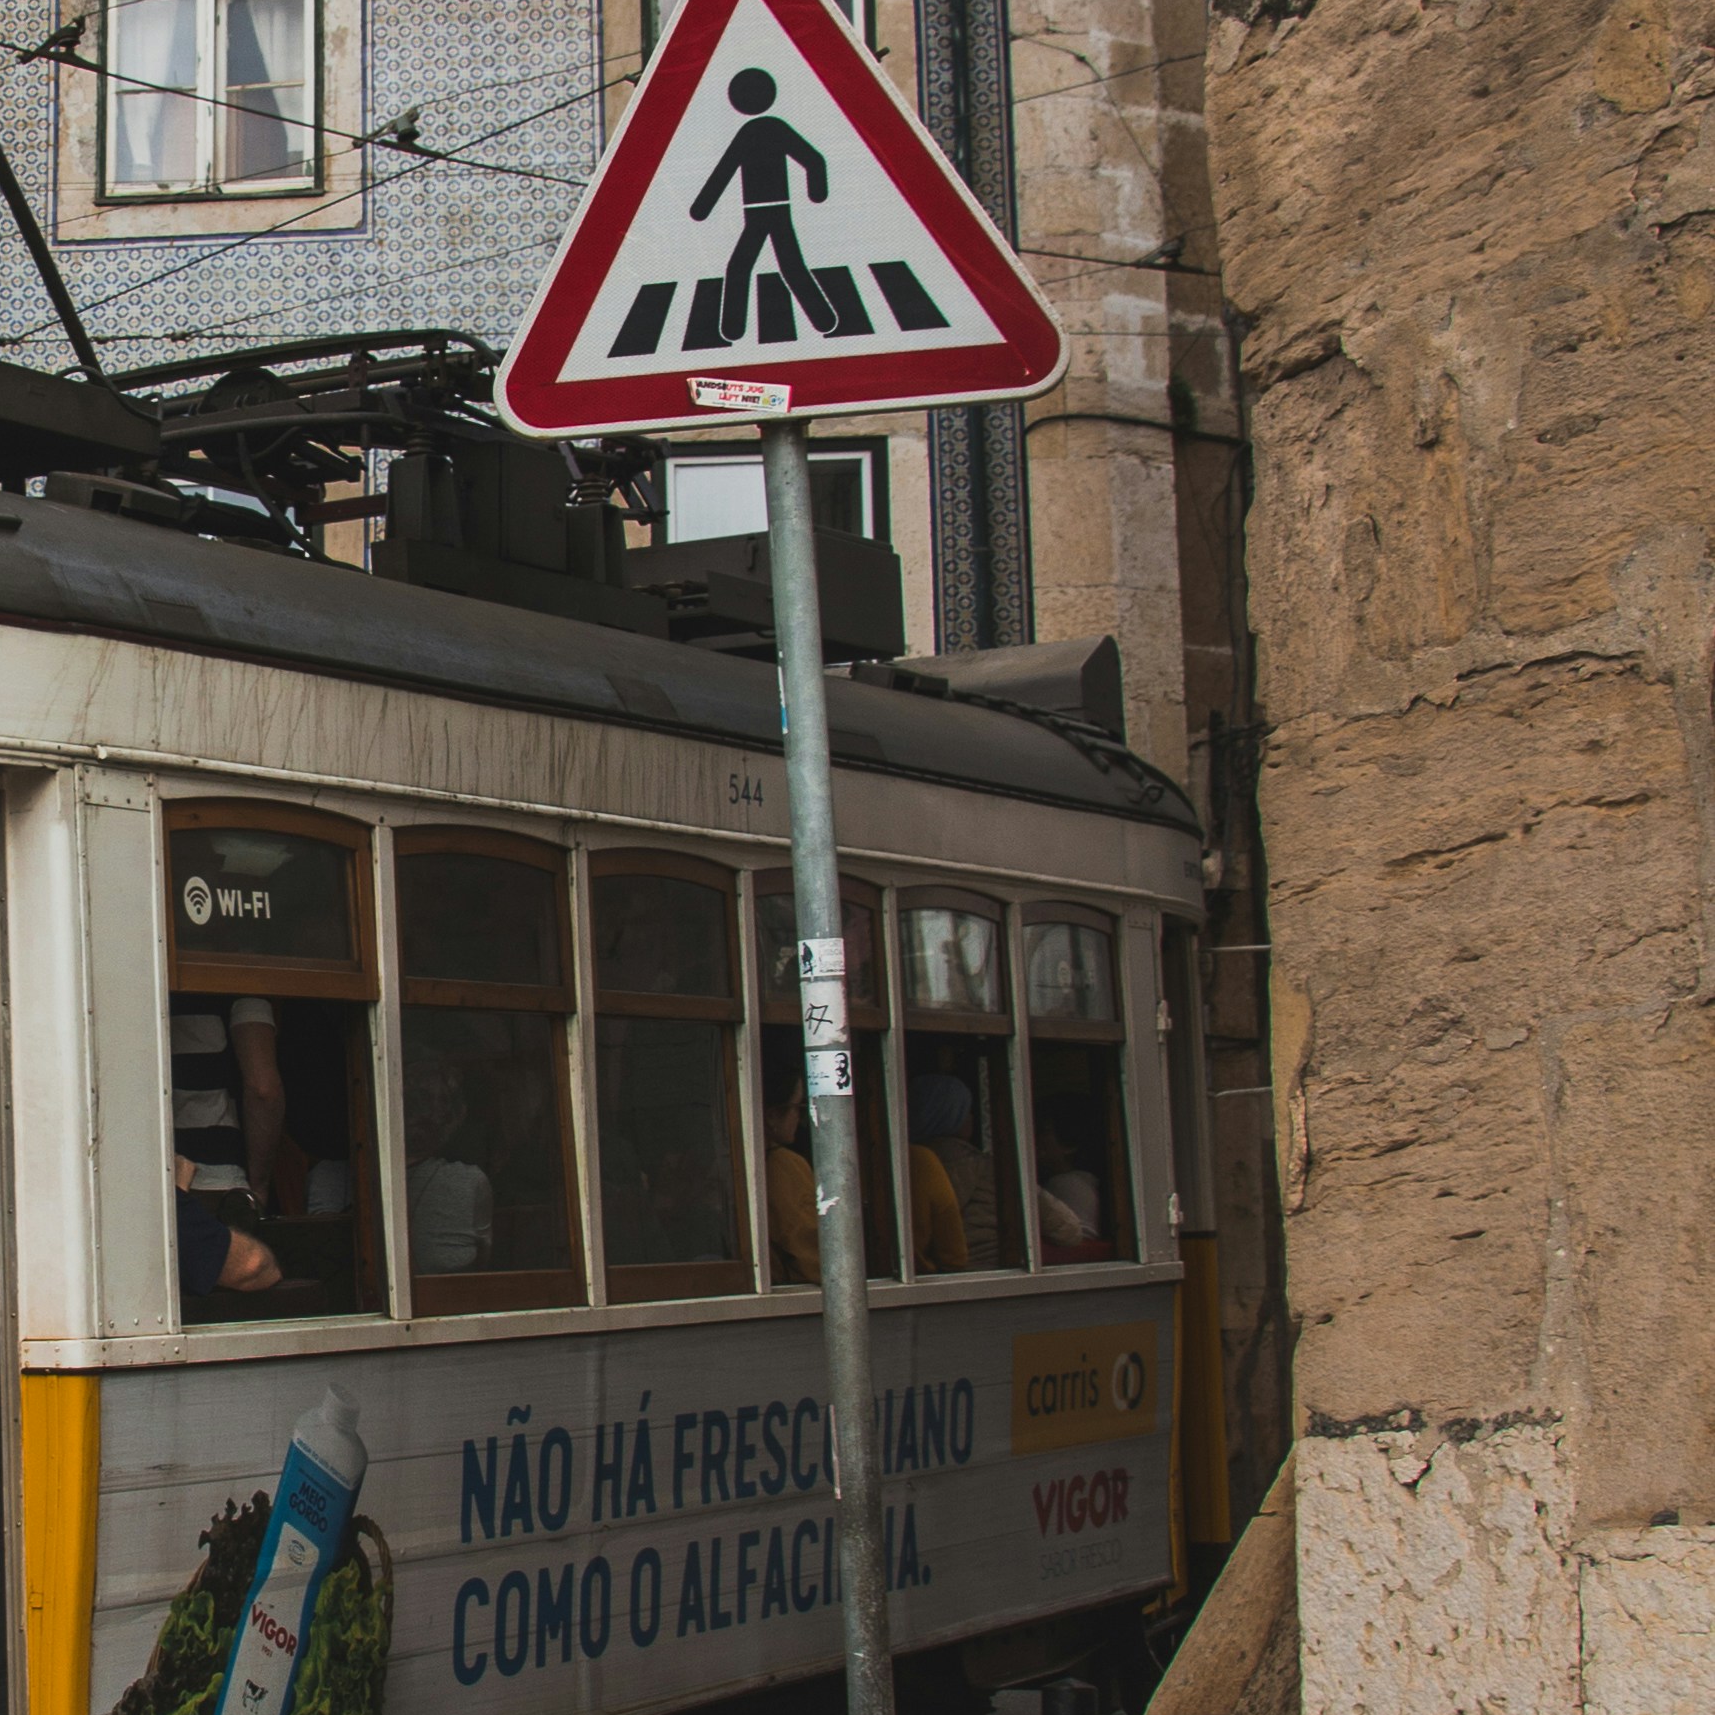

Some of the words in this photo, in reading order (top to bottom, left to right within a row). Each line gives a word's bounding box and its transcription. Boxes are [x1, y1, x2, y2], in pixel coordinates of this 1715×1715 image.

[728, 773, 764, 808] 544
[215, 887, 272, 919] WI-FI
[1026, 1352, 1100, 1417] carris
[460, 1403, 574, 1545] NÃO
[591, 1389, 658, 1524] HÁ
[288, 1492, 329, 1534] GORDO
[298, 1481, 327, 1512] MEIO
[1031, 1467, 1130, 1539] VIGOR
[452, 1555, 614, 1687] COMO
[629, 1546, 663, 1649] O
[675, 1502, 933, 1640] ALFACIA.
[250, 1604, 298, 1658] VIGOR
